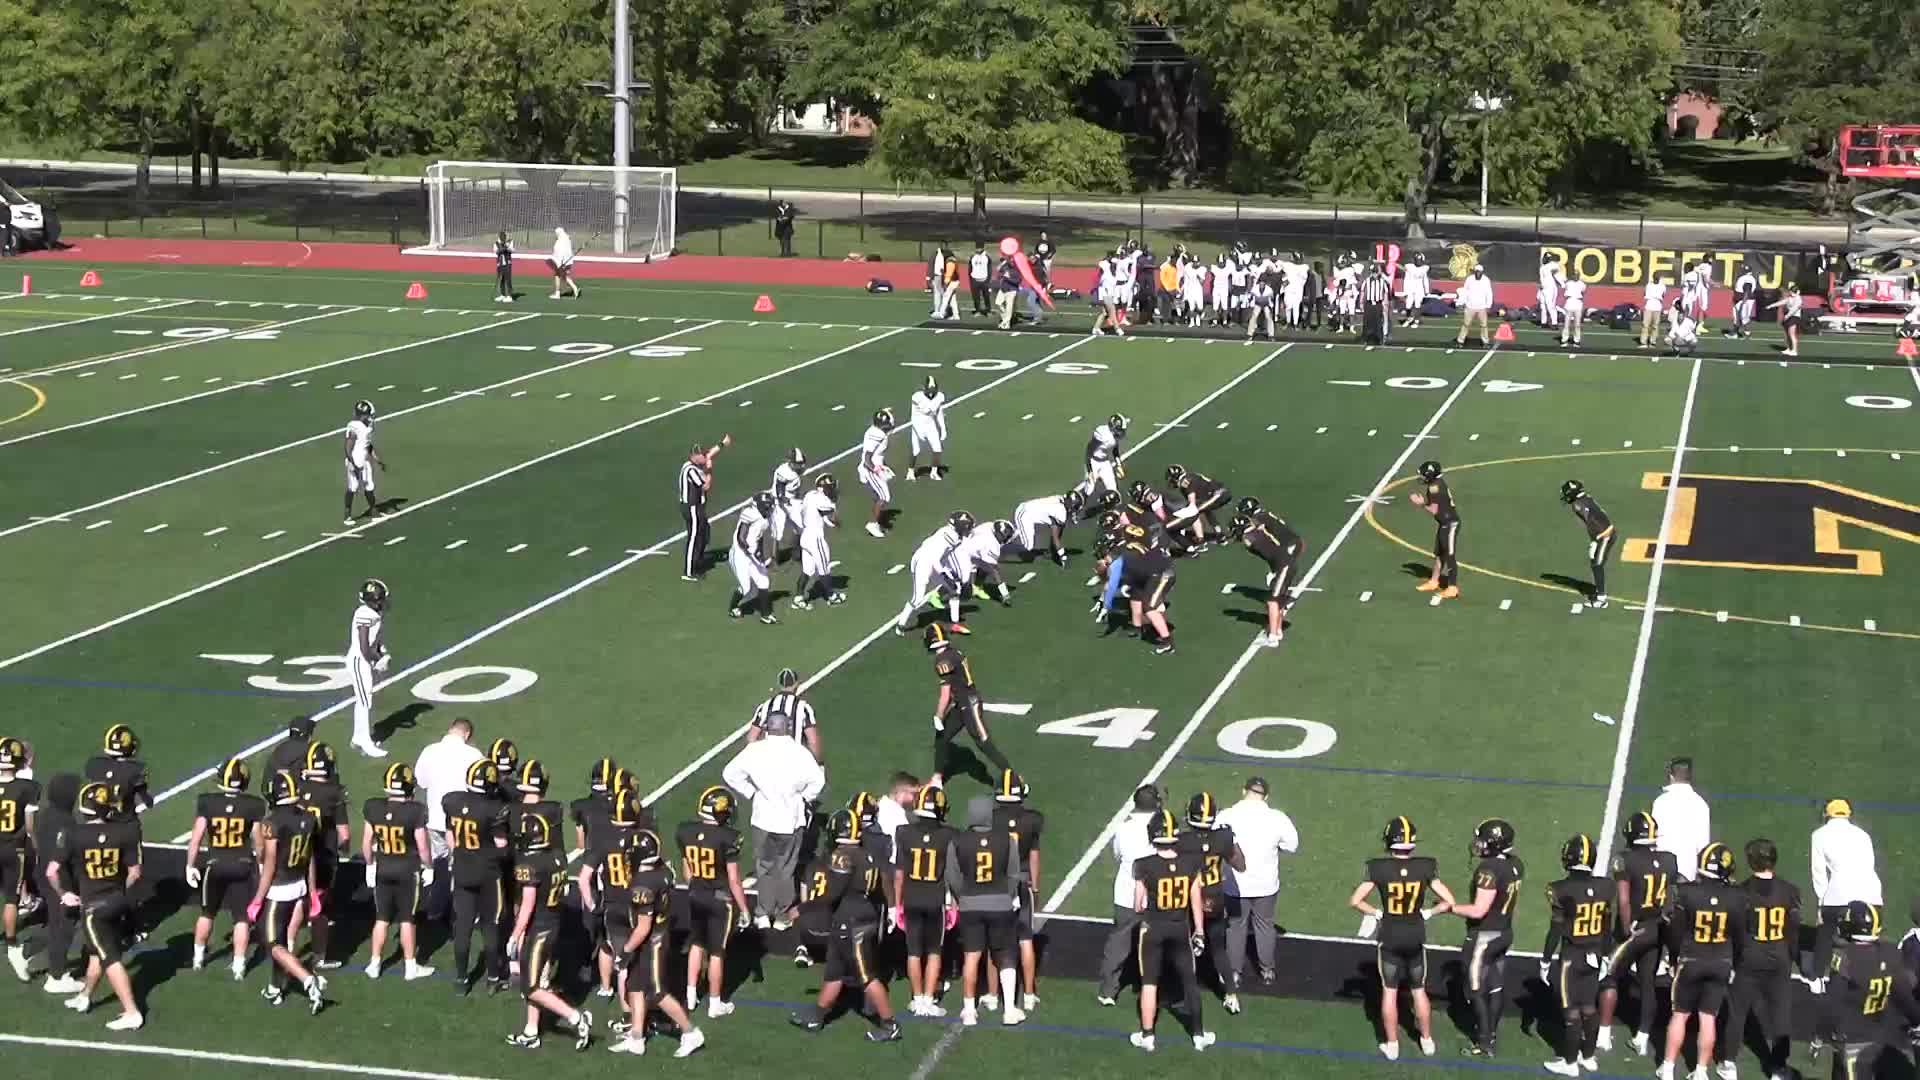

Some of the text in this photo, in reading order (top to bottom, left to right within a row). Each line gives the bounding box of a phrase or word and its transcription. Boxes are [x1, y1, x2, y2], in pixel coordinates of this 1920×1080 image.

[1036, 707, 1338, 759] 40
[211, 817, 245, 848] 32
[450, 816, 480, 850] 76
[909, 848, 937, 881] 11
[975, 852, 993, 883] 2
[1200, 855, 1222, 888] 3
[1157, 876, 1190, 911] 83
[1388, 881, 1421, 915] 27
[1641, 873, 1667, 909] 14
[1572, 901, 1607, 937] 26
[1694, 911, 1729, 943] 51
[1754, 907, 1785, 941] 19
